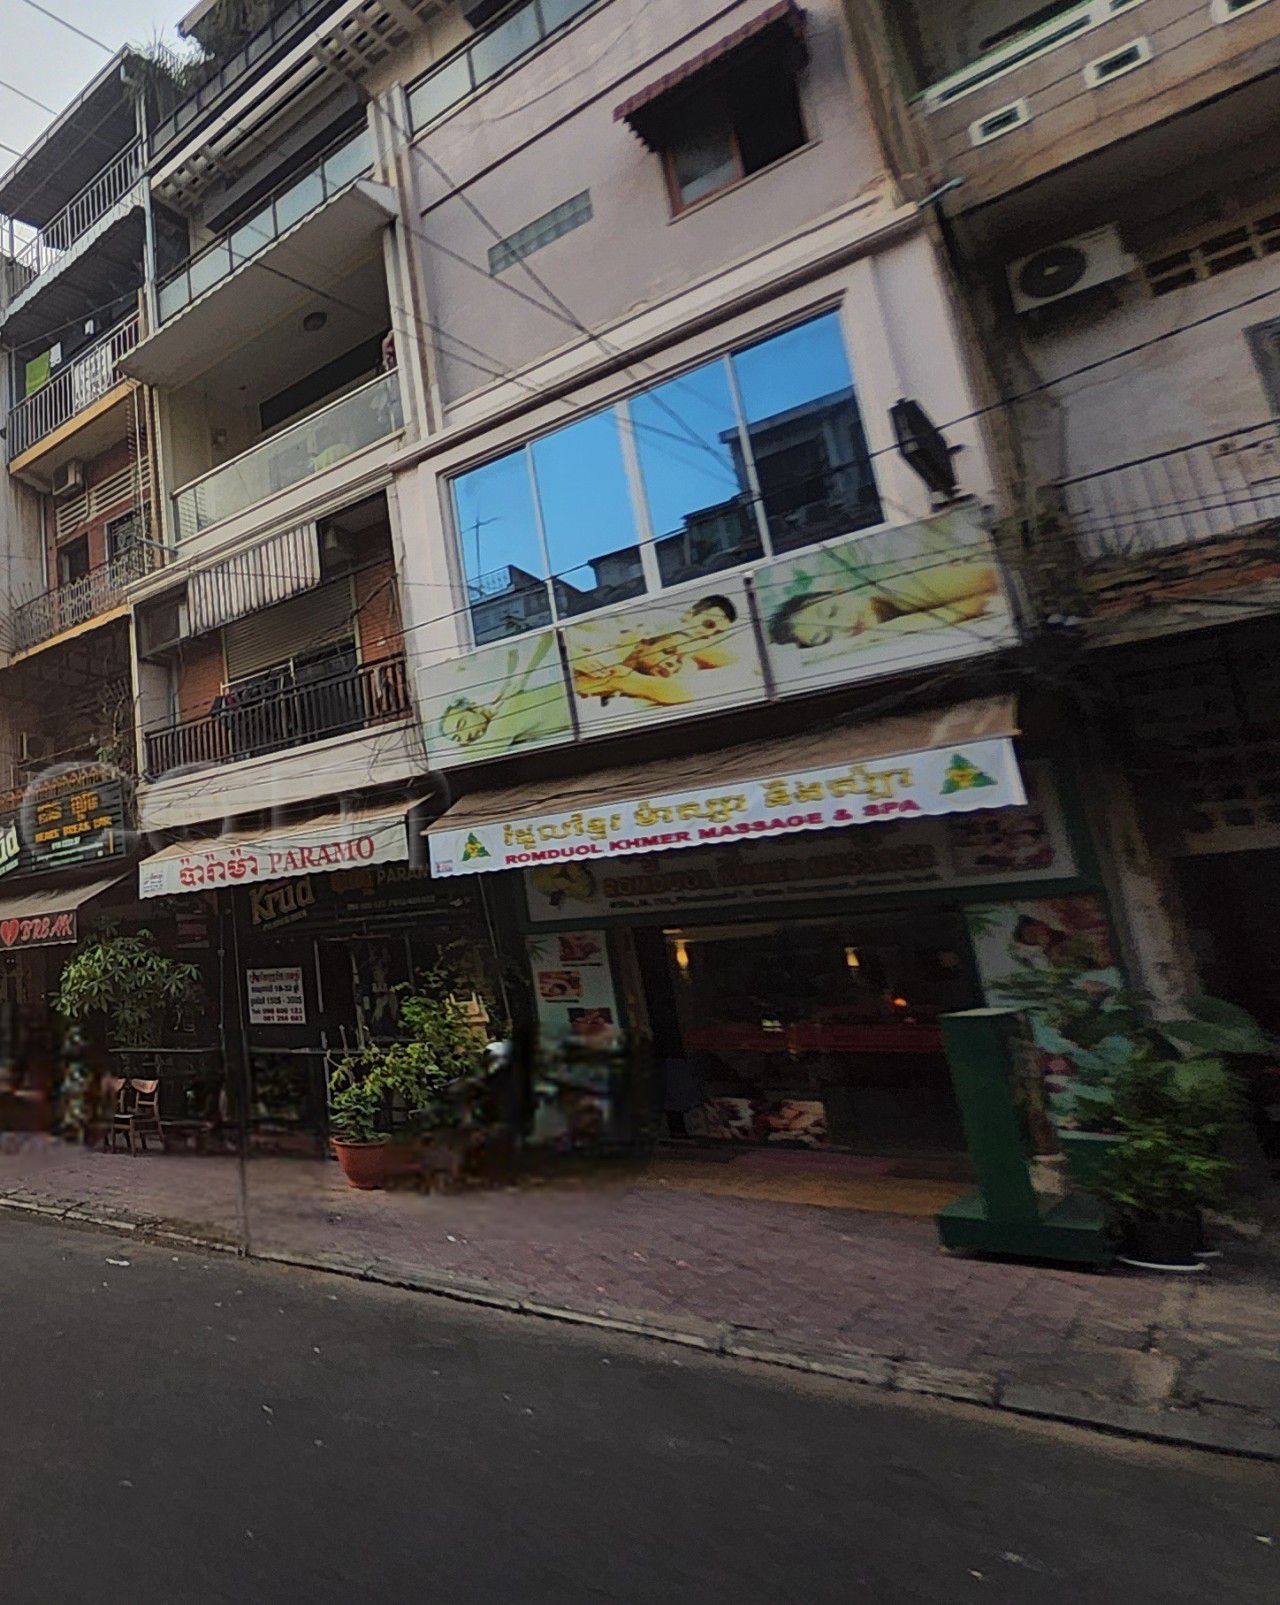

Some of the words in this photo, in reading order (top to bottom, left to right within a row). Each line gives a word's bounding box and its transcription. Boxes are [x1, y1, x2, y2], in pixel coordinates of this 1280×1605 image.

[268, 834, 375, 875] PARAMO
[505, 844, 603, 865] ROMDUOL
[609, 831, 692, 851] KHMER
[698, 812, 824, 839] MASSAGE
[832, 808, 854, 822] &
[862, 799, 922, 816] SPA
